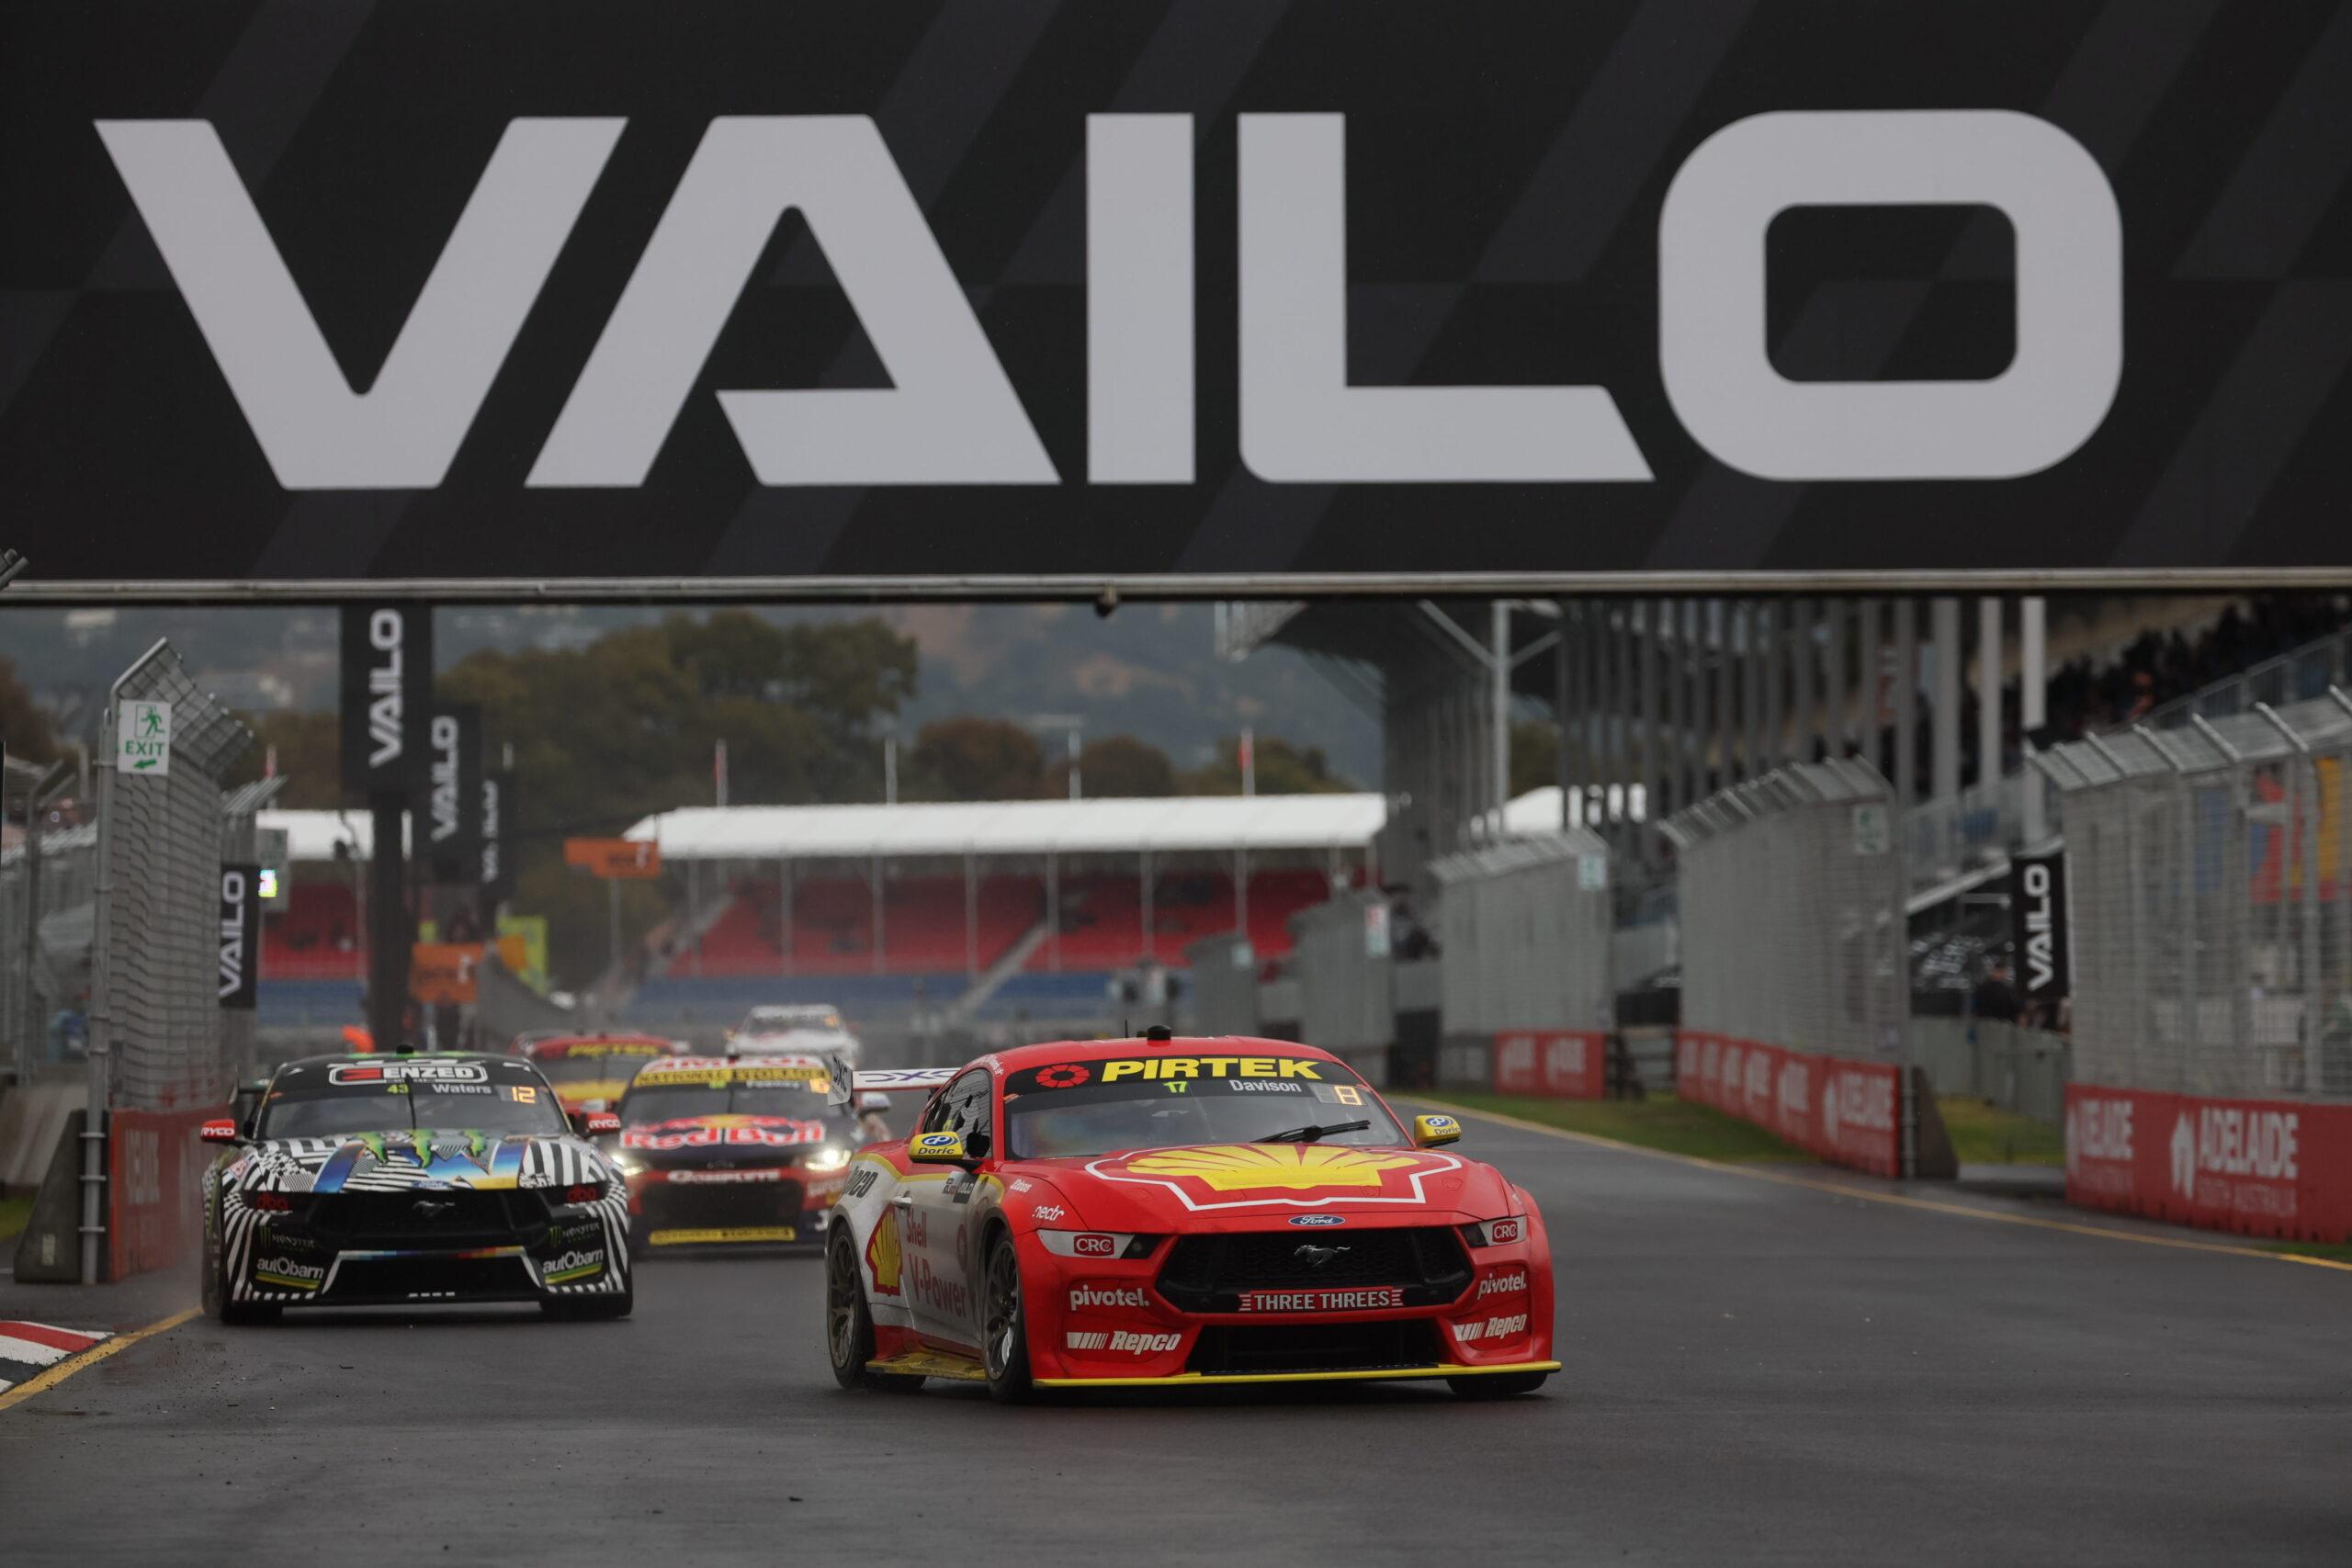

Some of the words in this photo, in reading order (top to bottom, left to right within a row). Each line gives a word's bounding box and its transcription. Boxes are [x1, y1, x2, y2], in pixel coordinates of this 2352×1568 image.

[94, 107, 2125, 491] VAILO
[368, 607, 403, 768] VAILO
[125, 740, 164, 756] EXIT
[431, 716, 458, 841] VAILO
[219, 871, 245, 998] VAILO
[2023, 863, 2054, 992] VAILO
[383, 1066, 475, 1079] ENZED
[1101, 1057, 1323, 1083] PIRTEK
[432, 1083, 492, 1095] Waters
[512, 1086, 536, 1104] 12
[1163, 1080, 1188, 1093] 17
[1229, 1079, 1303, 1093] Davison
[201, 1126, 235, 1137] RYCO
[620, 1127, 722, 1150] Red
[724, 1122, 825, 1145] Bull
[1434, 1126, 1461, 1135] Doric
[2199, 1105, 2299, 1180] ADELAIDE
[907, 1207, 927, 1247] Shell
[1299, 1216, 1335, 1225] Ford
[1493, 1224, 1517, 1240] CRC
[1076, 1237, 1113, 1253] CRC
[908, 1253, 967, 1319] V-Power
[1254, 1294, 1316, 1311] THREE
[1319, 1291, 1390, 1309] THREES
[1485, 1314, 1528, 1339] Repco
[1109, 1330, 1182, 1356] Repco
